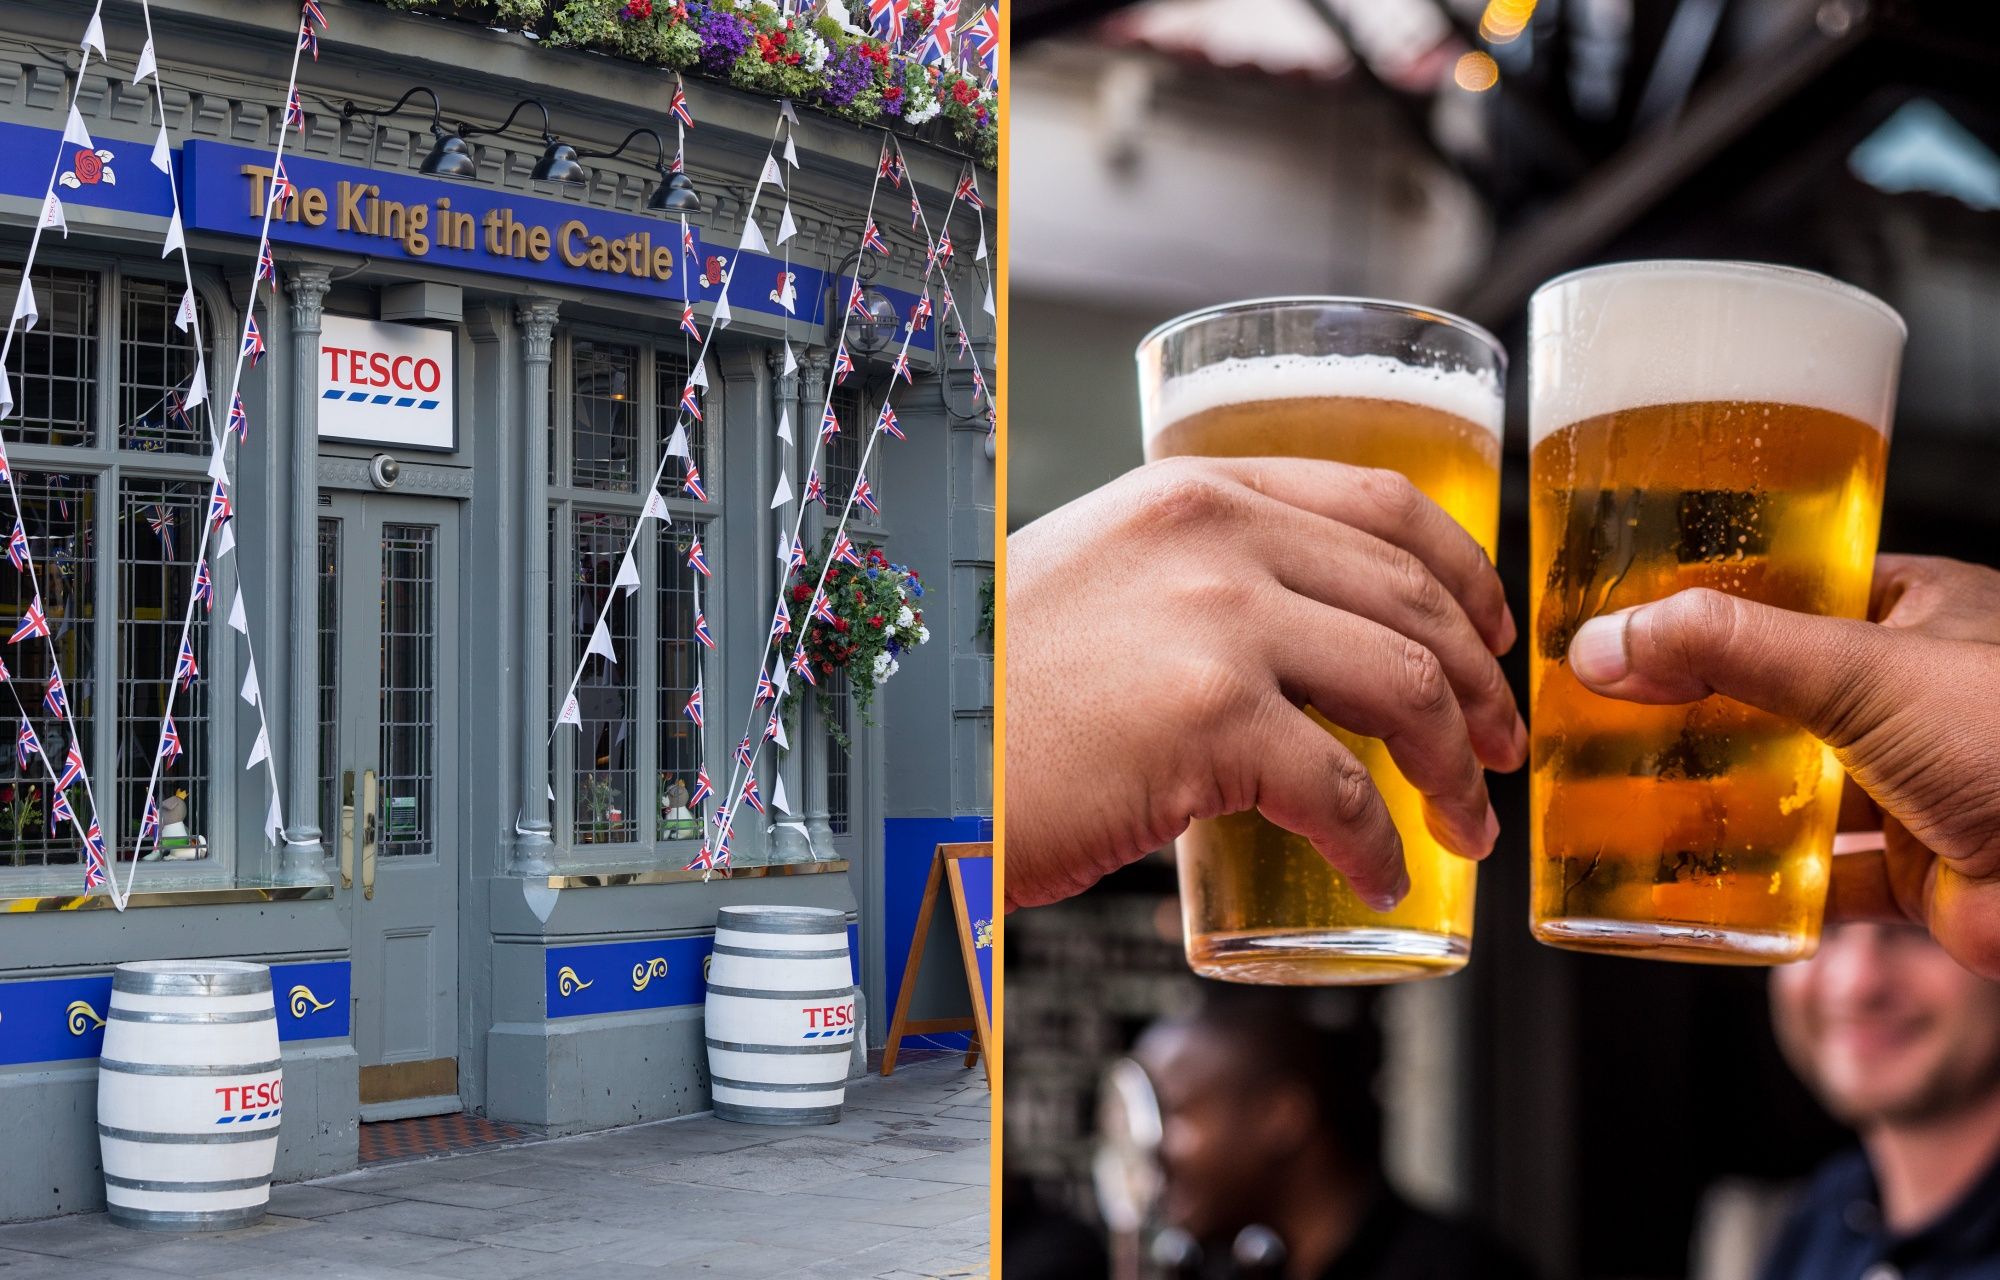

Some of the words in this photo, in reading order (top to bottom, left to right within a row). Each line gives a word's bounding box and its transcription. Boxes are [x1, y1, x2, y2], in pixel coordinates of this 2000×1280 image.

[47, 197, 55, 222] TESCO
[336, 180, 430, 256] King
[436, 197, 476, 249] in
[483, 207, 550, 262] the
[556, 219, 674, 281] Castle
[321, 346, 441, 392] TESCO
[564, 699, 576, 718] TESCO
[803, 1003, 855, 1028] TESC
[215, 1079, 283, 1111] TESC
